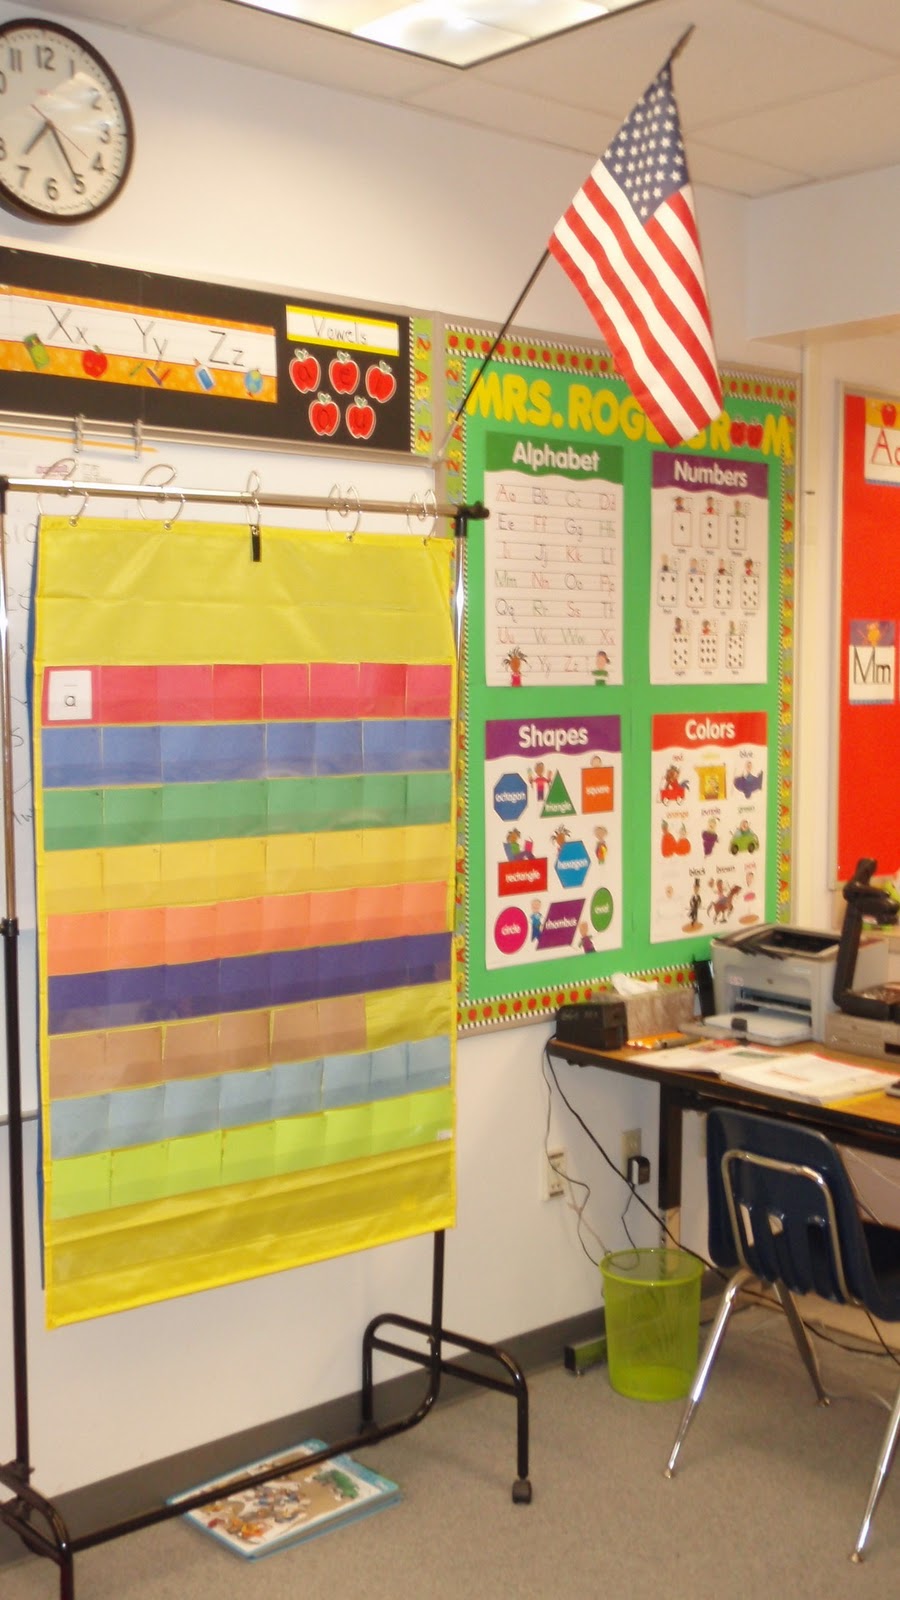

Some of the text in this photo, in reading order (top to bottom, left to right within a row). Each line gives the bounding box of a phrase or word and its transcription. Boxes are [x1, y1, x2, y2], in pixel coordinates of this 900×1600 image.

[9, 48, 22, 73] 11
[36, 45, 55, 71] 12
[100, 123, 110, 144] 3
[92, 153, 104, 175] 4
[17, 165, 30, 189] 7
[74, 173, 86, 195] 5
[46, 178, 59, 200] 6
[311, 315, 369, 345] Vowels
[209, 329, 245, 367] Zz
[467, 369, 564, 428] MRS.
[512, 440, 600, 472] Alphabet
[674, 459, 748, 489] Numbers
[853, 645, 892, 685] Mm
[518, 723, 589, 752] Shapes
[685, 717, 735, 740] Colors
[495, 791, 527, 804] octagon
[505, 869, 541, 883] rectangle
[557, 859, 589, 871] hexagon
[501, 923, 521, 936] circle
[546, 916, 578, 930] rhombus
